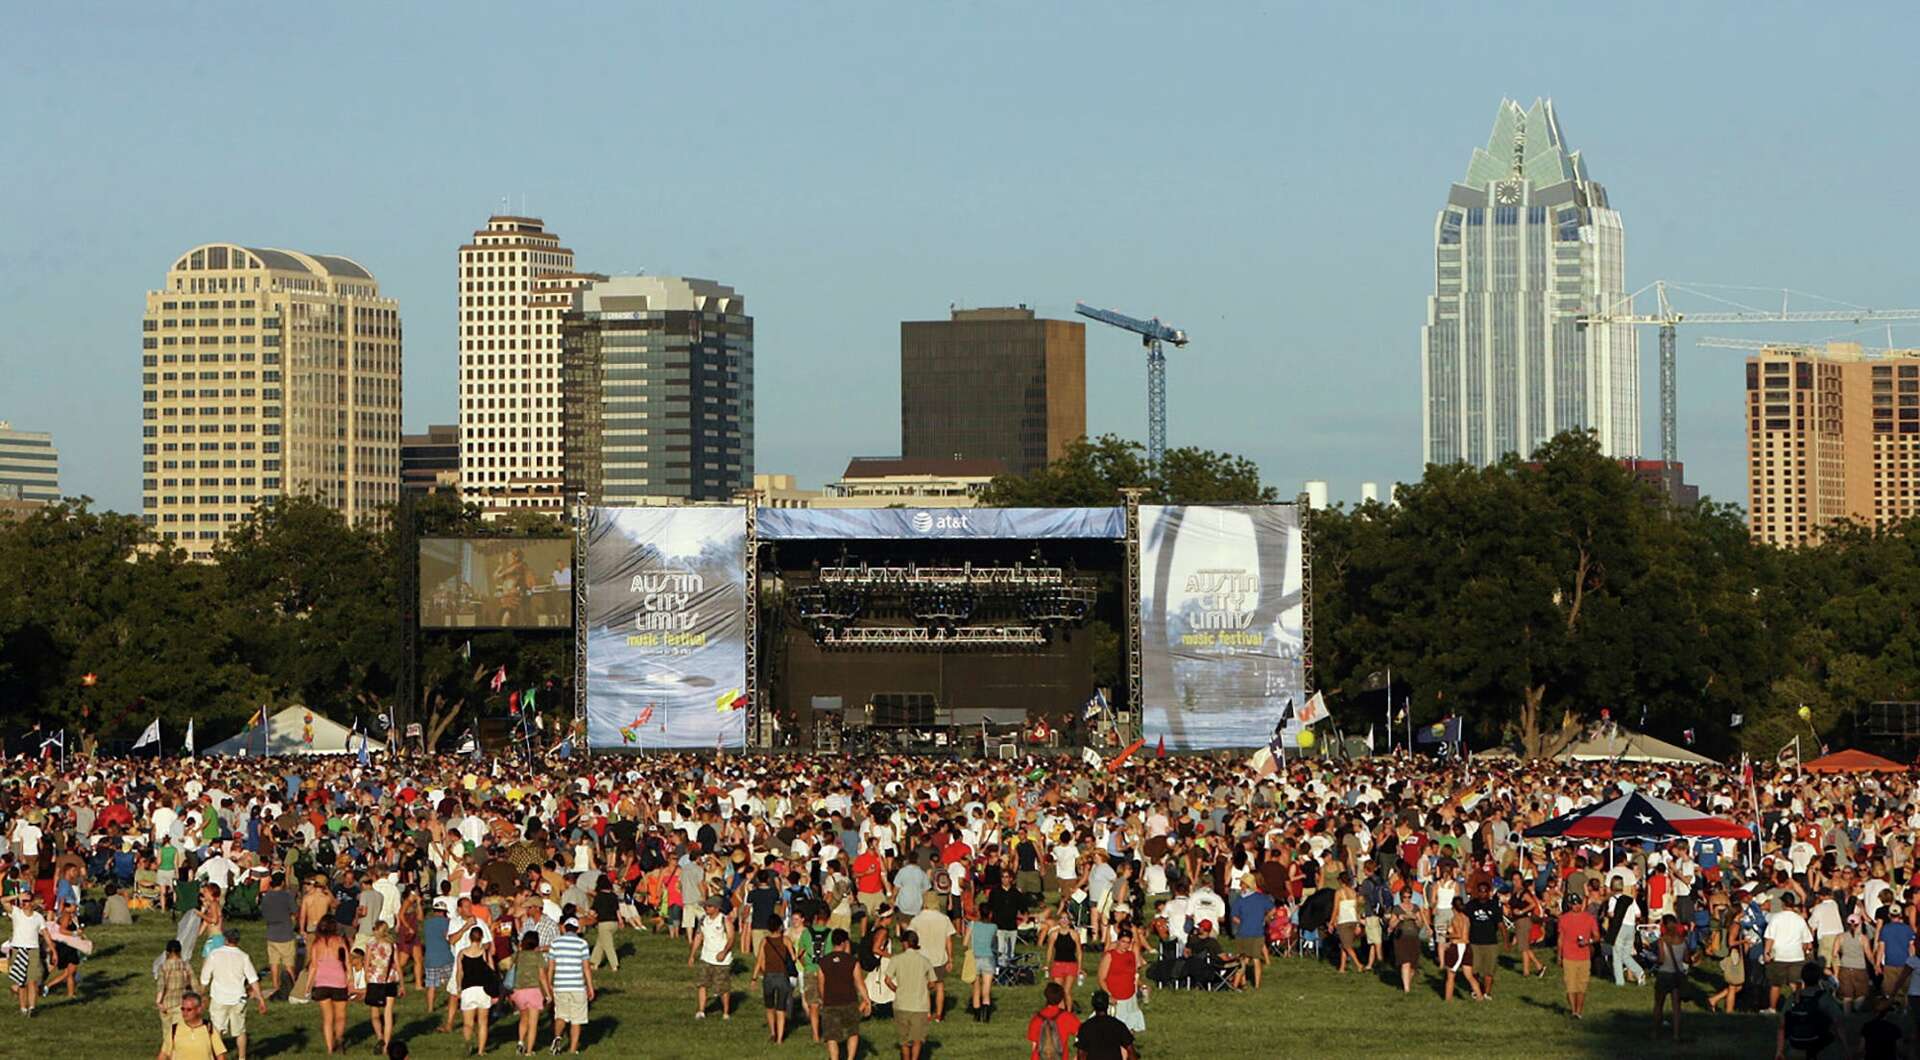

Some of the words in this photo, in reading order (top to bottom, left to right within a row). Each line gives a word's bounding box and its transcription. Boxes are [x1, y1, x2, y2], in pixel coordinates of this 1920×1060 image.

[936, 514, 968, 529] at&t
[630, 574, 704, 593] AUSTIN
[1184, 574, 1259, 593] AUSTIN
[644, 592, 689, 611] CITY
[1199, 592, 1245, 611] CITY
[635, 611, 699, 631] LIMITS
[626, 631, 657, 648] music
[664, 631, 706, 647] festival
[1183, 631, 1216, 646] music
[1218, 630, 1264, 646] festival
[1809, 828, 1817, 839] 3
